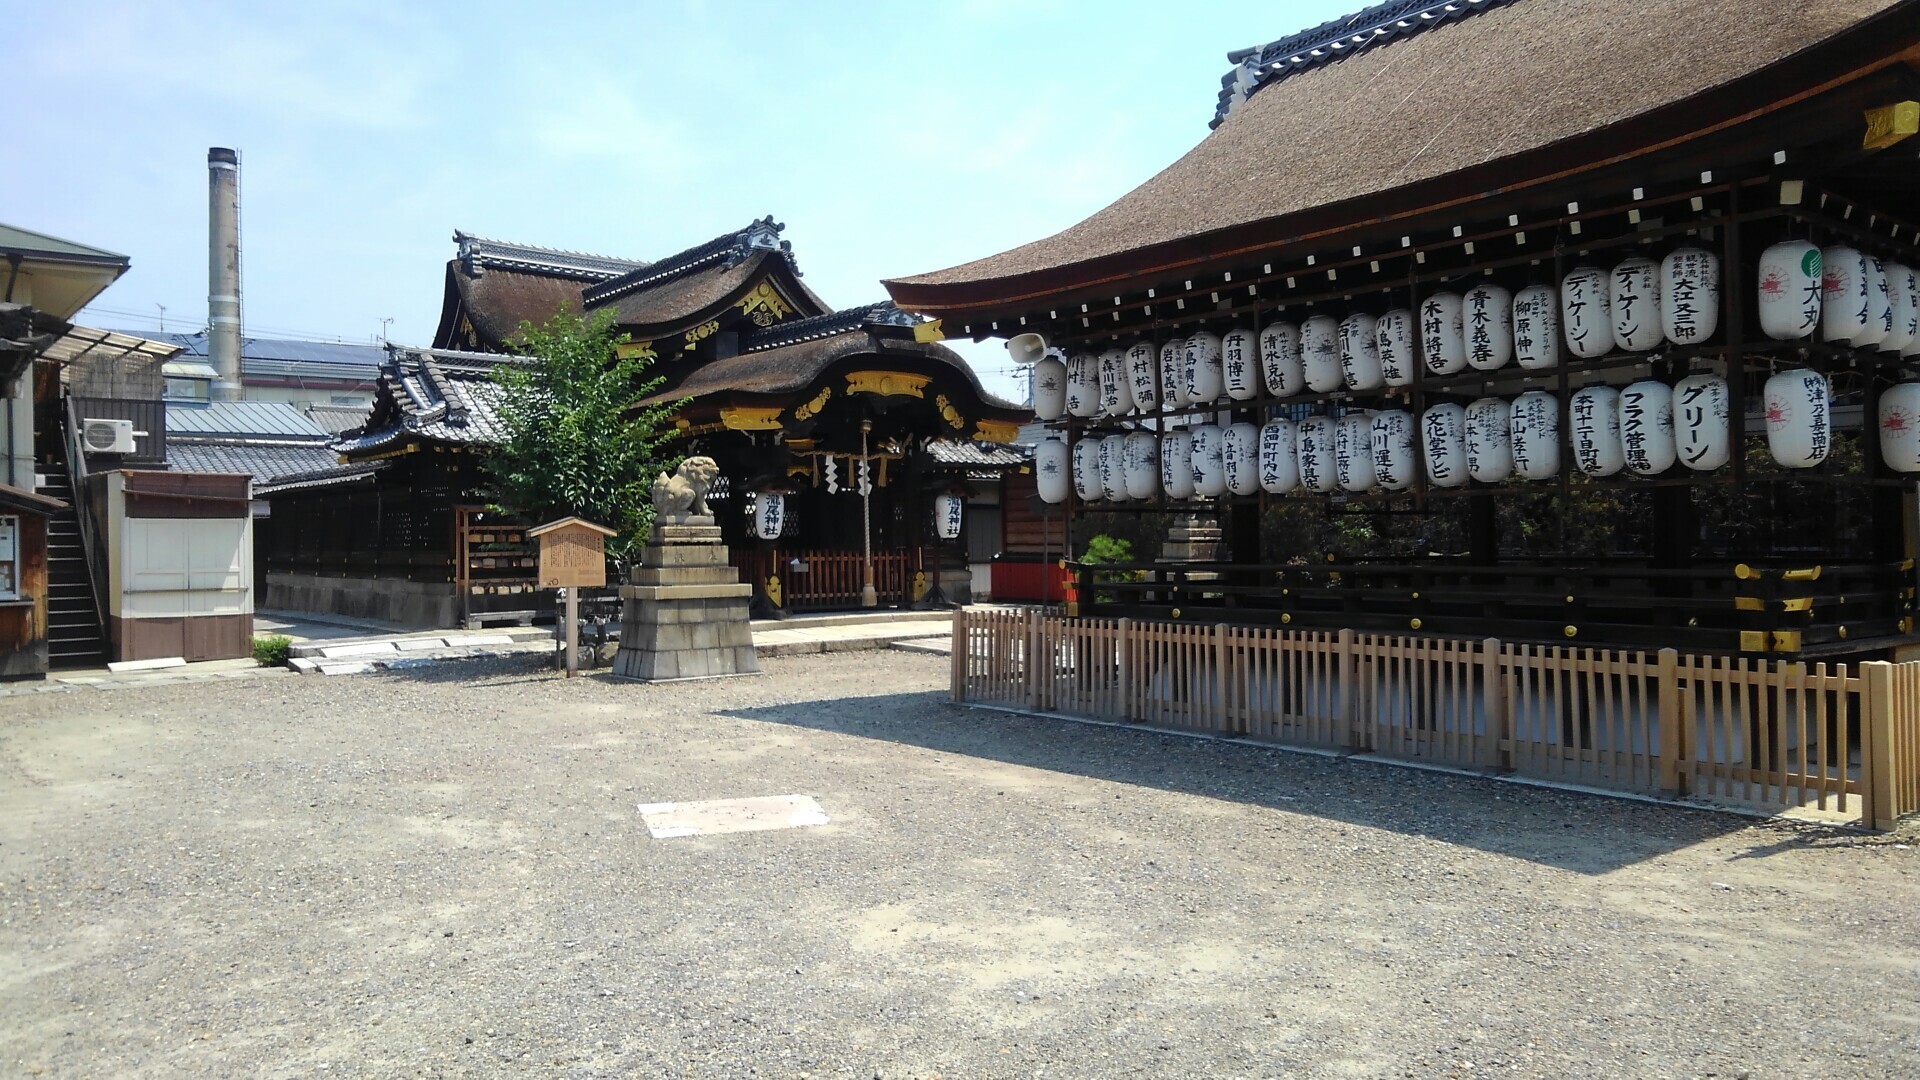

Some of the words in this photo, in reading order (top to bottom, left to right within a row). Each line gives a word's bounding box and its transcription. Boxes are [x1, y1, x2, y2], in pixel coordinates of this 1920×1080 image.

[1469, 289, 1494, 362] 青木義春
[1514, 300, 1536, 361] 柳原伸一
[1567, 275, 1590, 352] ディケーシー
[1617, 266, 1641, 347] ディケーシー
[1672, 278, 1700, 340] 大江又三郎
[1800, 280, 1822, 329] 大丸
[1102, 358, 1119, 407] 森川勝治
[1226, 334, 1246, 391] 丹羽博三
[1263, 333, 1285, 391] 清水克樹
[1300, 422, 1320, 490] 中島家具店
[1371, 418, 1399, 484] 山川運送
[1426, 412, 1450, 479] 文化堂テレビ
[1465, 409, 1480, 473] 山本次男
[1511, 405, 1529, 471] 上山孝行
[1575, 394, 1603, 473] 本町十二丁目町内会
[1681, 386, 1709, 464] グリーン
